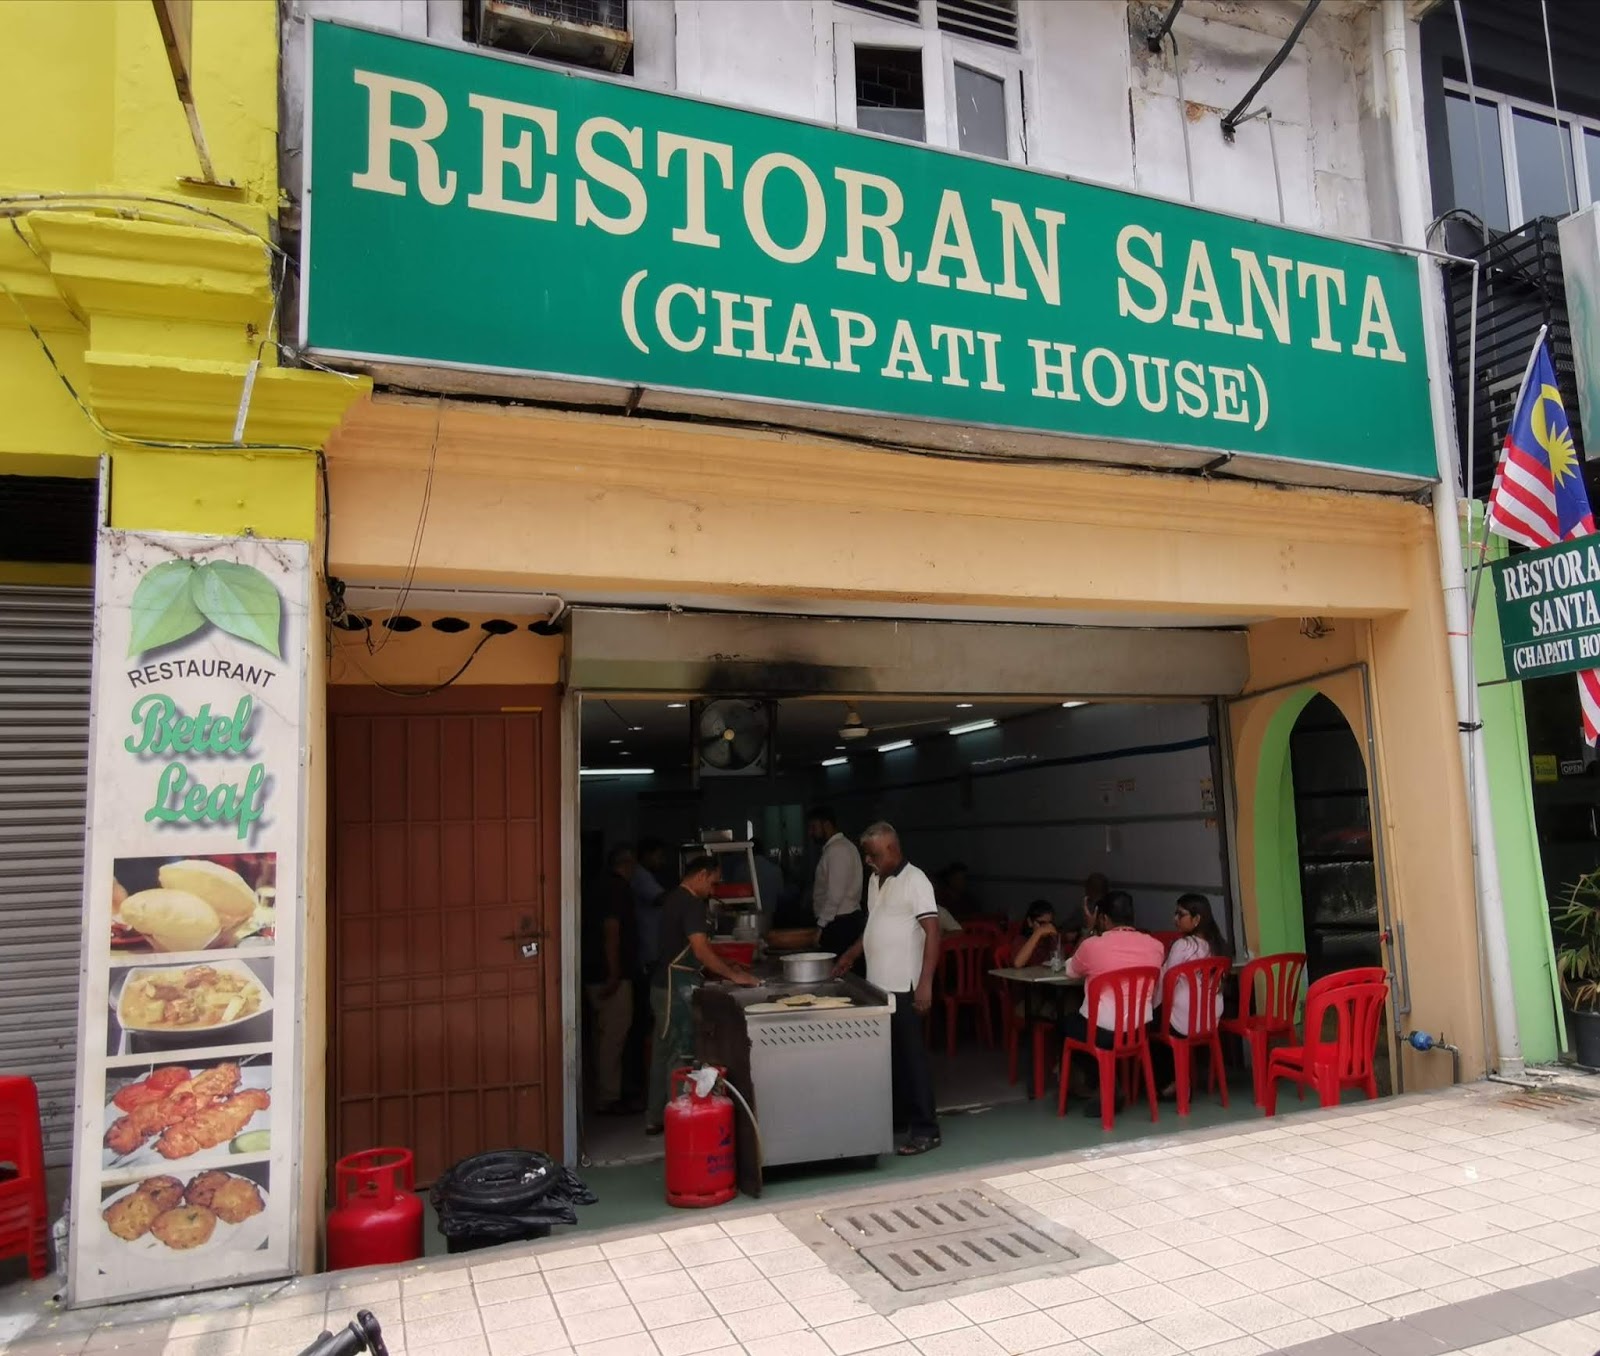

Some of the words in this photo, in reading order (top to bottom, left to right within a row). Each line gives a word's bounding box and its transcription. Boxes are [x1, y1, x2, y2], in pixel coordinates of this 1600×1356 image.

[352, 69, 1066, 306] RESTORAN
[1116, 224, 1407, 363] SANTA
[621, 269, 1006, 392] (CHAPATI
[1027, 338, 1269, 432] HOUSE)
[1502, 544, 1600, 602] RESTORA
[1530, 589, 1600, 637] SANTA
[127, 659, 276, 688] RESTAURANT
[1513, 638, 1575, 675] (CHAPATI
[1578, 633, 1600, 659] HO
[124, 693, 253, 754] Betel
[1563, 763, 1583, 774] OPEN
[144, 761, 265, 840] Leaf
